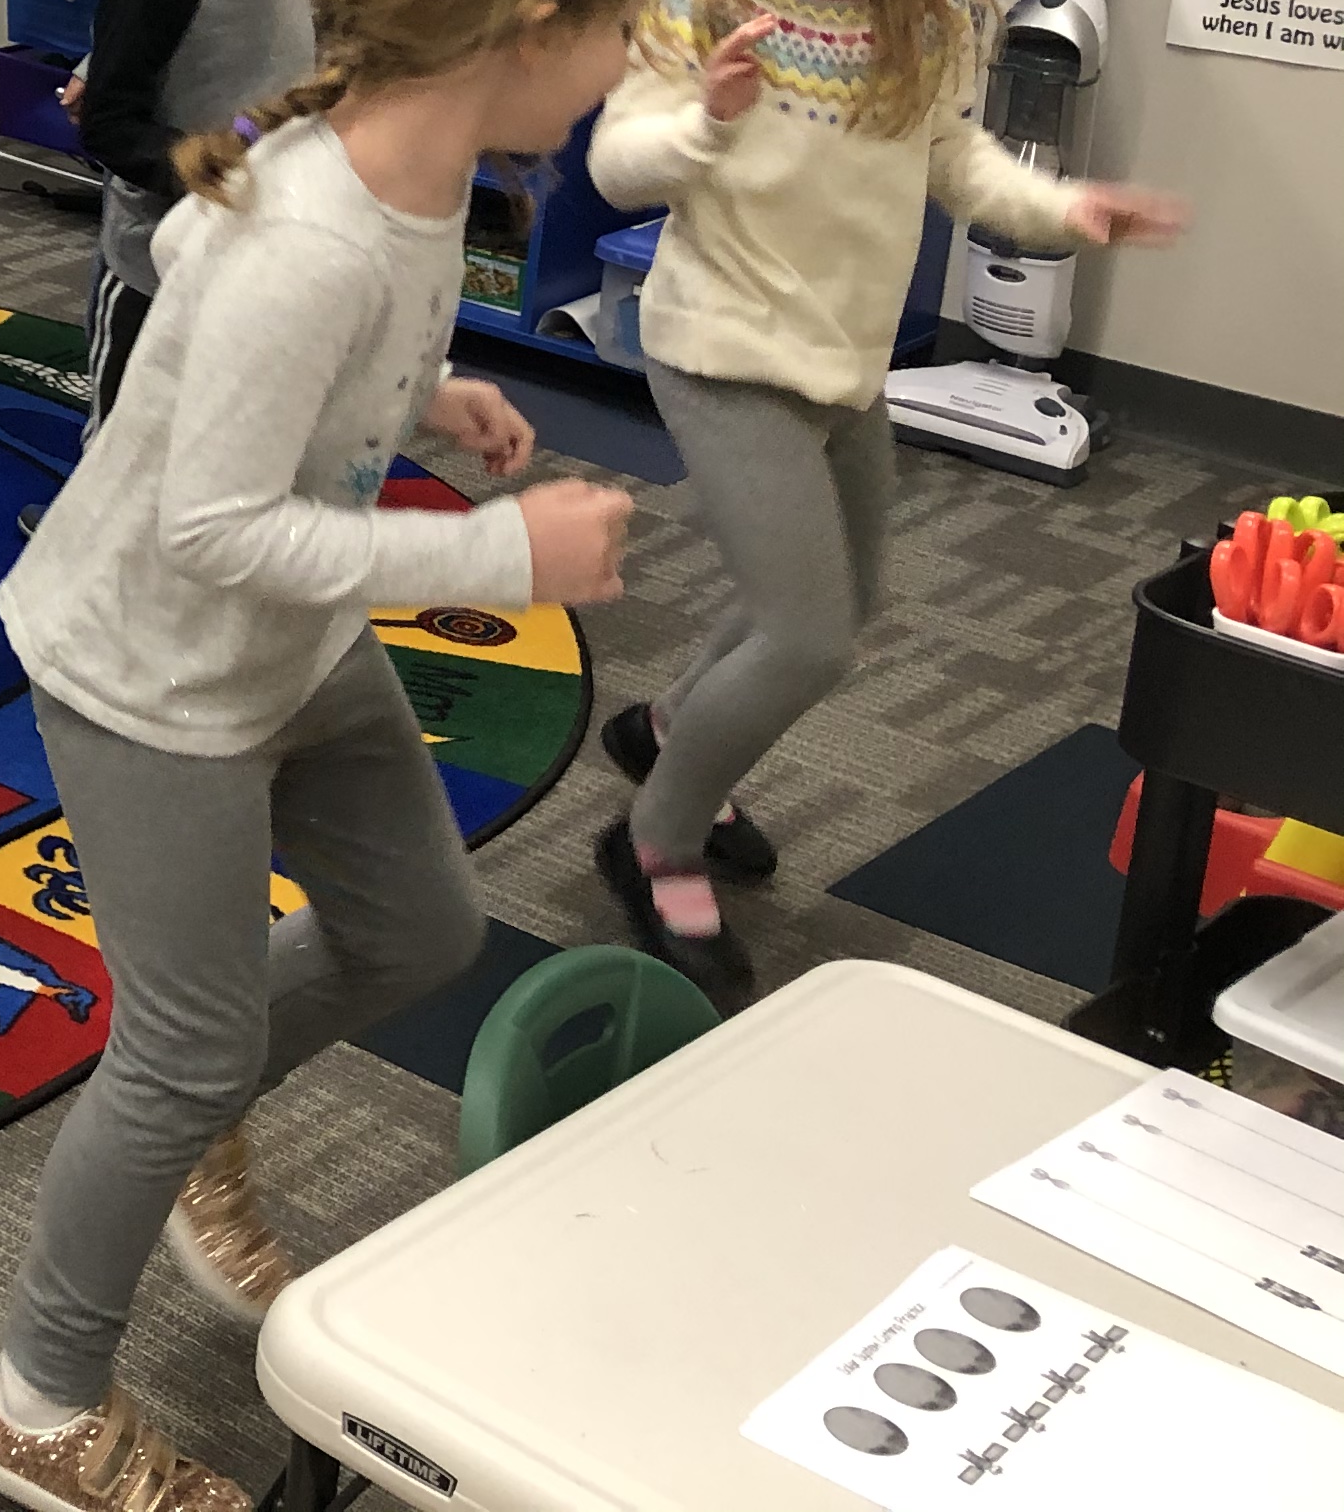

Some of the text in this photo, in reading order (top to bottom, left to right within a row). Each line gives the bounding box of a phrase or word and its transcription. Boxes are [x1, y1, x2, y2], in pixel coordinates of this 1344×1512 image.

[1201, 14, 1315, 47] when I am
[355, 1422, 442, 1486] LIFETIME
